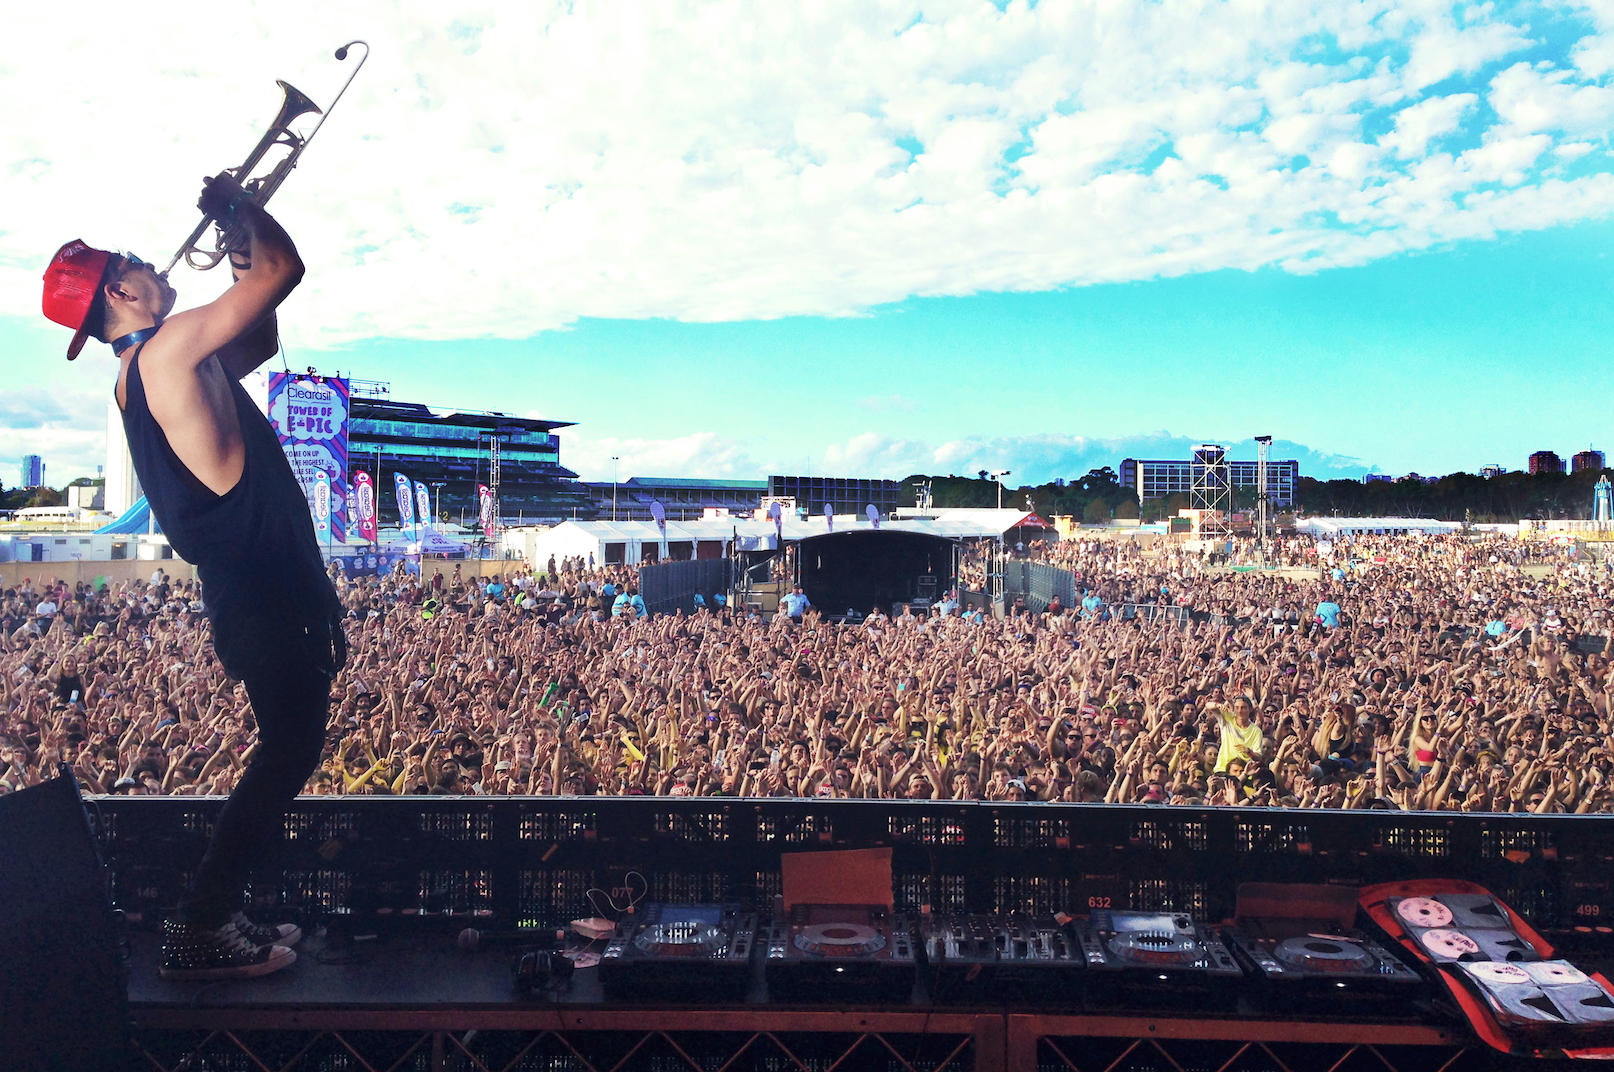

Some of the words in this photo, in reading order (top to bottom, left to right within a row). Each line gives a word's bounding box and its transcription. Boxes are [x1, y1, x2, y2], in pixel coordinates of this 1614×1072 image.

[287, 387, 331, 400] Clearasil
[287, 405, 319, 416] TOWER
[320, 407, 333, 417] OF
[285, 450, 302, 458] COME
[302, 450, 312, 458] ON
[311, 450, 320, 458] UP
[611, 886, 634, 899] 077
[1088, 896, 1112, 909] 632
[1577, 904, 1600, 916] 499
